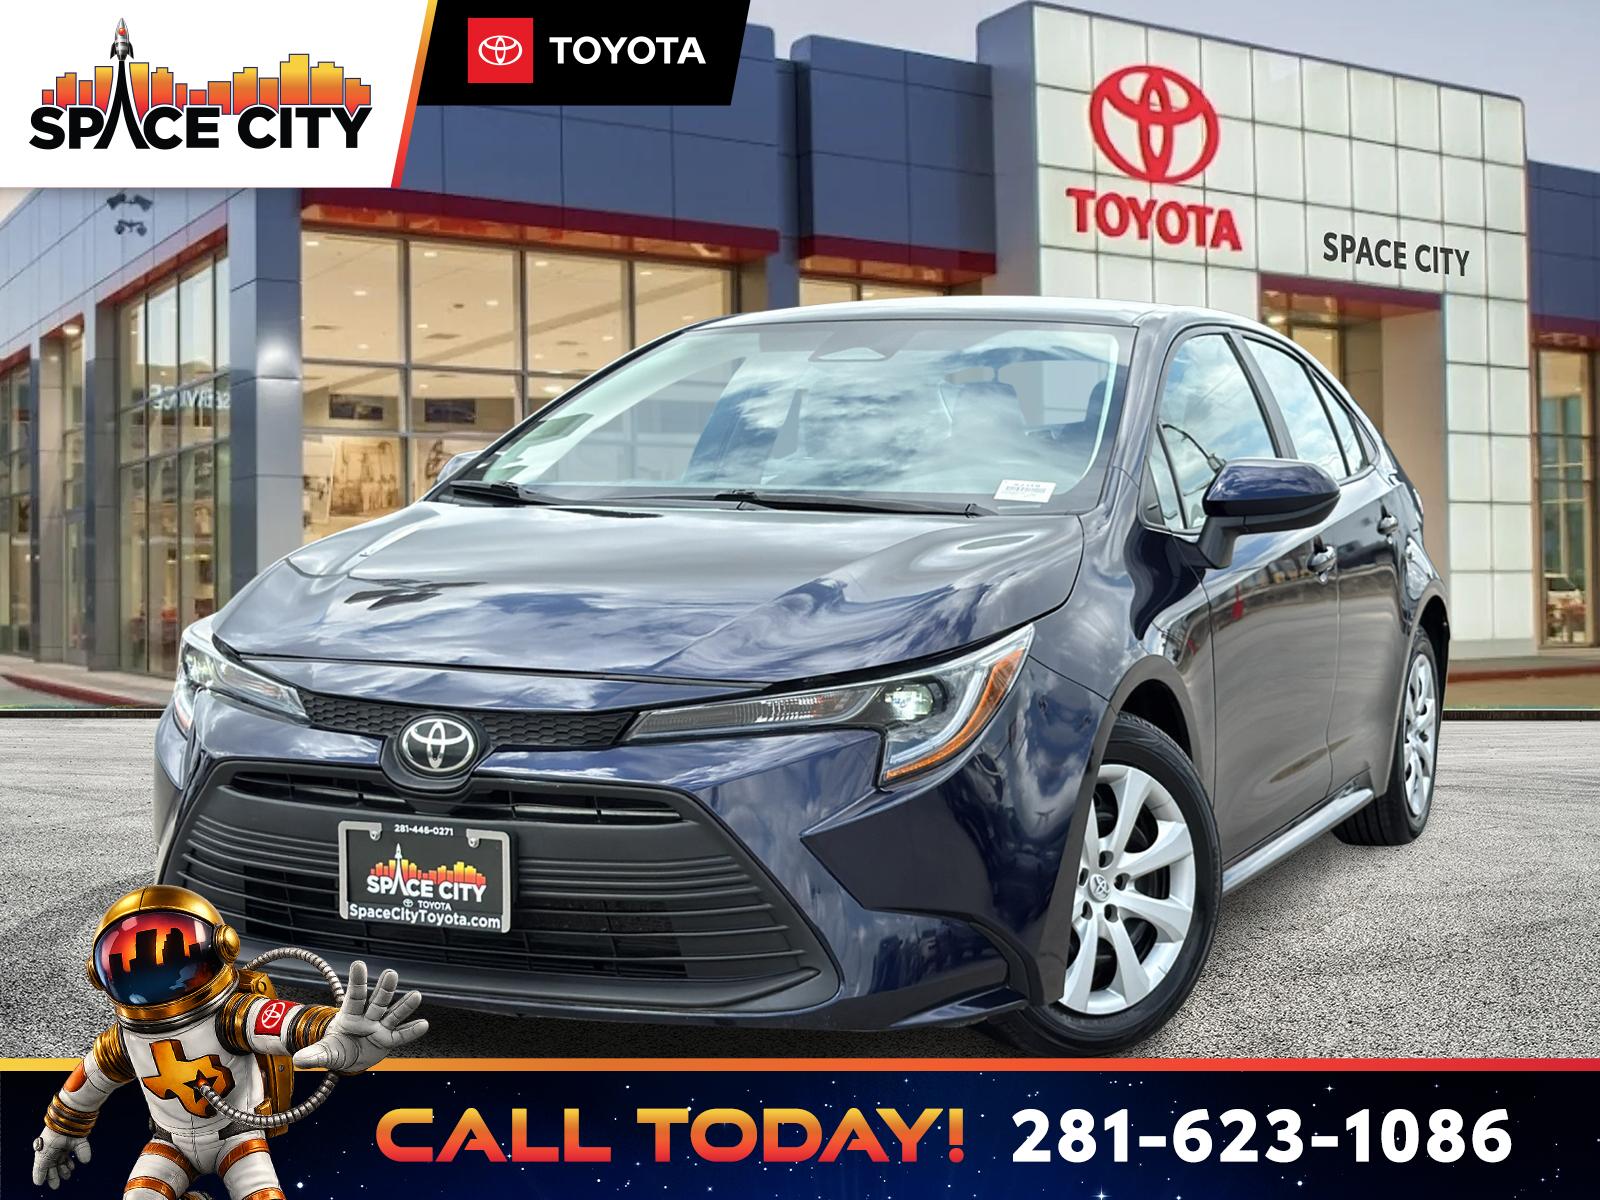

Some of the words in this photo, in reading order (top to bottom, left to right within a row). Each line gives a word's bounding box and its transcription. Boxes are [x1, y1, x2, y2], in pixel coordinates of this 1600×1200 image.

[1066, 188, 1242, 251] TOYOTA
[1323, 232, 1407, 270] SPACE
[1414, 244, 1470, 277] CITY
[366, 875, 434, 898] SPACE
[438, 881, 487, 903] CITY
[349, 903, 501, 929] SpaceCityToyota.com
[417, 900, 452, 911] TOYOTA
